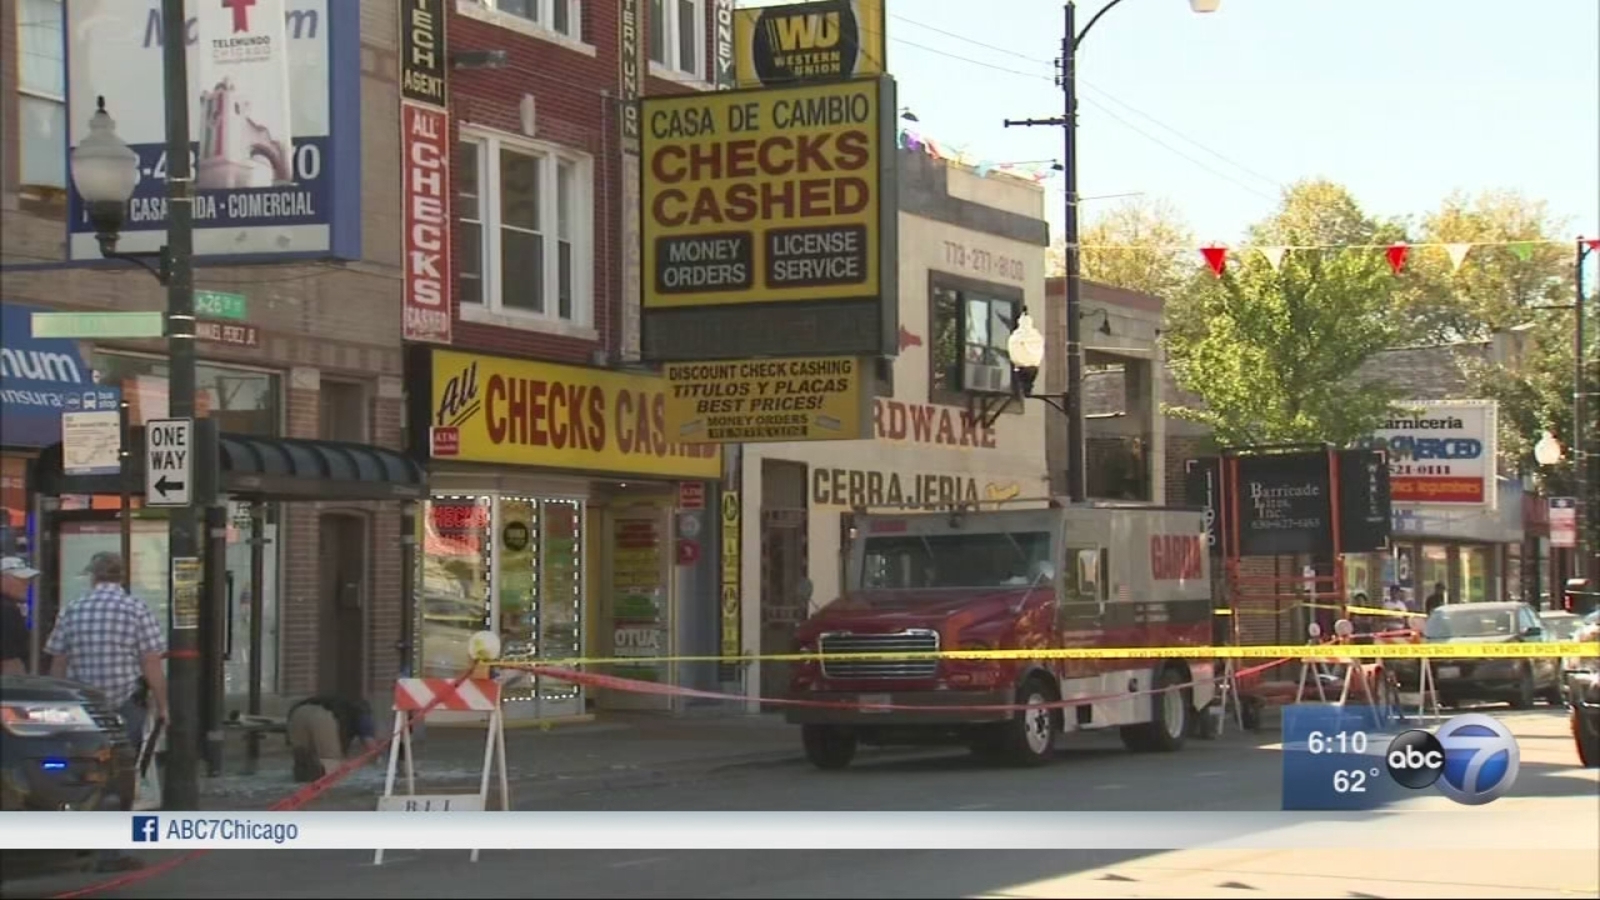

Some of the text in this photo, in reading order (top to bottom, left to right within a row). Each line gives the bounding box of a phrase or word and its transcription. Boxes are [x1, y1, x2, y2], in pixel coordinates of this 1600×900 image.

[212, 35, 271, 49] TELEMUNDO
[766, 12, 840, 52] WU
[774, 51, 841, 68] WESTERN
[794, 61, 841, 76] UNION
[404, 69, 444, 99] AGENT
[411, 109, 440, 140] ALL
[651, 93, 870, 140] CASA DE CAMBIO
[651, 130, 870, 184] CHECKS
[131, 191, 315, 222] CASA IDA COMERCIAL
[652, 176, 870, 228] CASHED
[411, 141, 441, 306] CHECKS
[669, 239, 741, 263] MONEY
[772, 231, 858, 256] LICENSE
[663, 263, 746, 287] ORDERS
[772, 256, 859, 281] SERVICE
[669, 360, 852, 381] DISCOUNT CHECK CASHING
[672, 378, 849, 399] TITULOS Y PLACAS
[435, 361, 480, 426] All
[485, 373, 606, 453] CHECKS
[696, 396, 825, 414] BEST PRICES!
[873, 400, 997, 449] RDWARE
[151, 427, 186, 448] ONE
[150, 450, 187, 471] WAY
[812, 467, 981, 512] CERRAJERIA
[1250, 481, 1321, 499] Barricade
